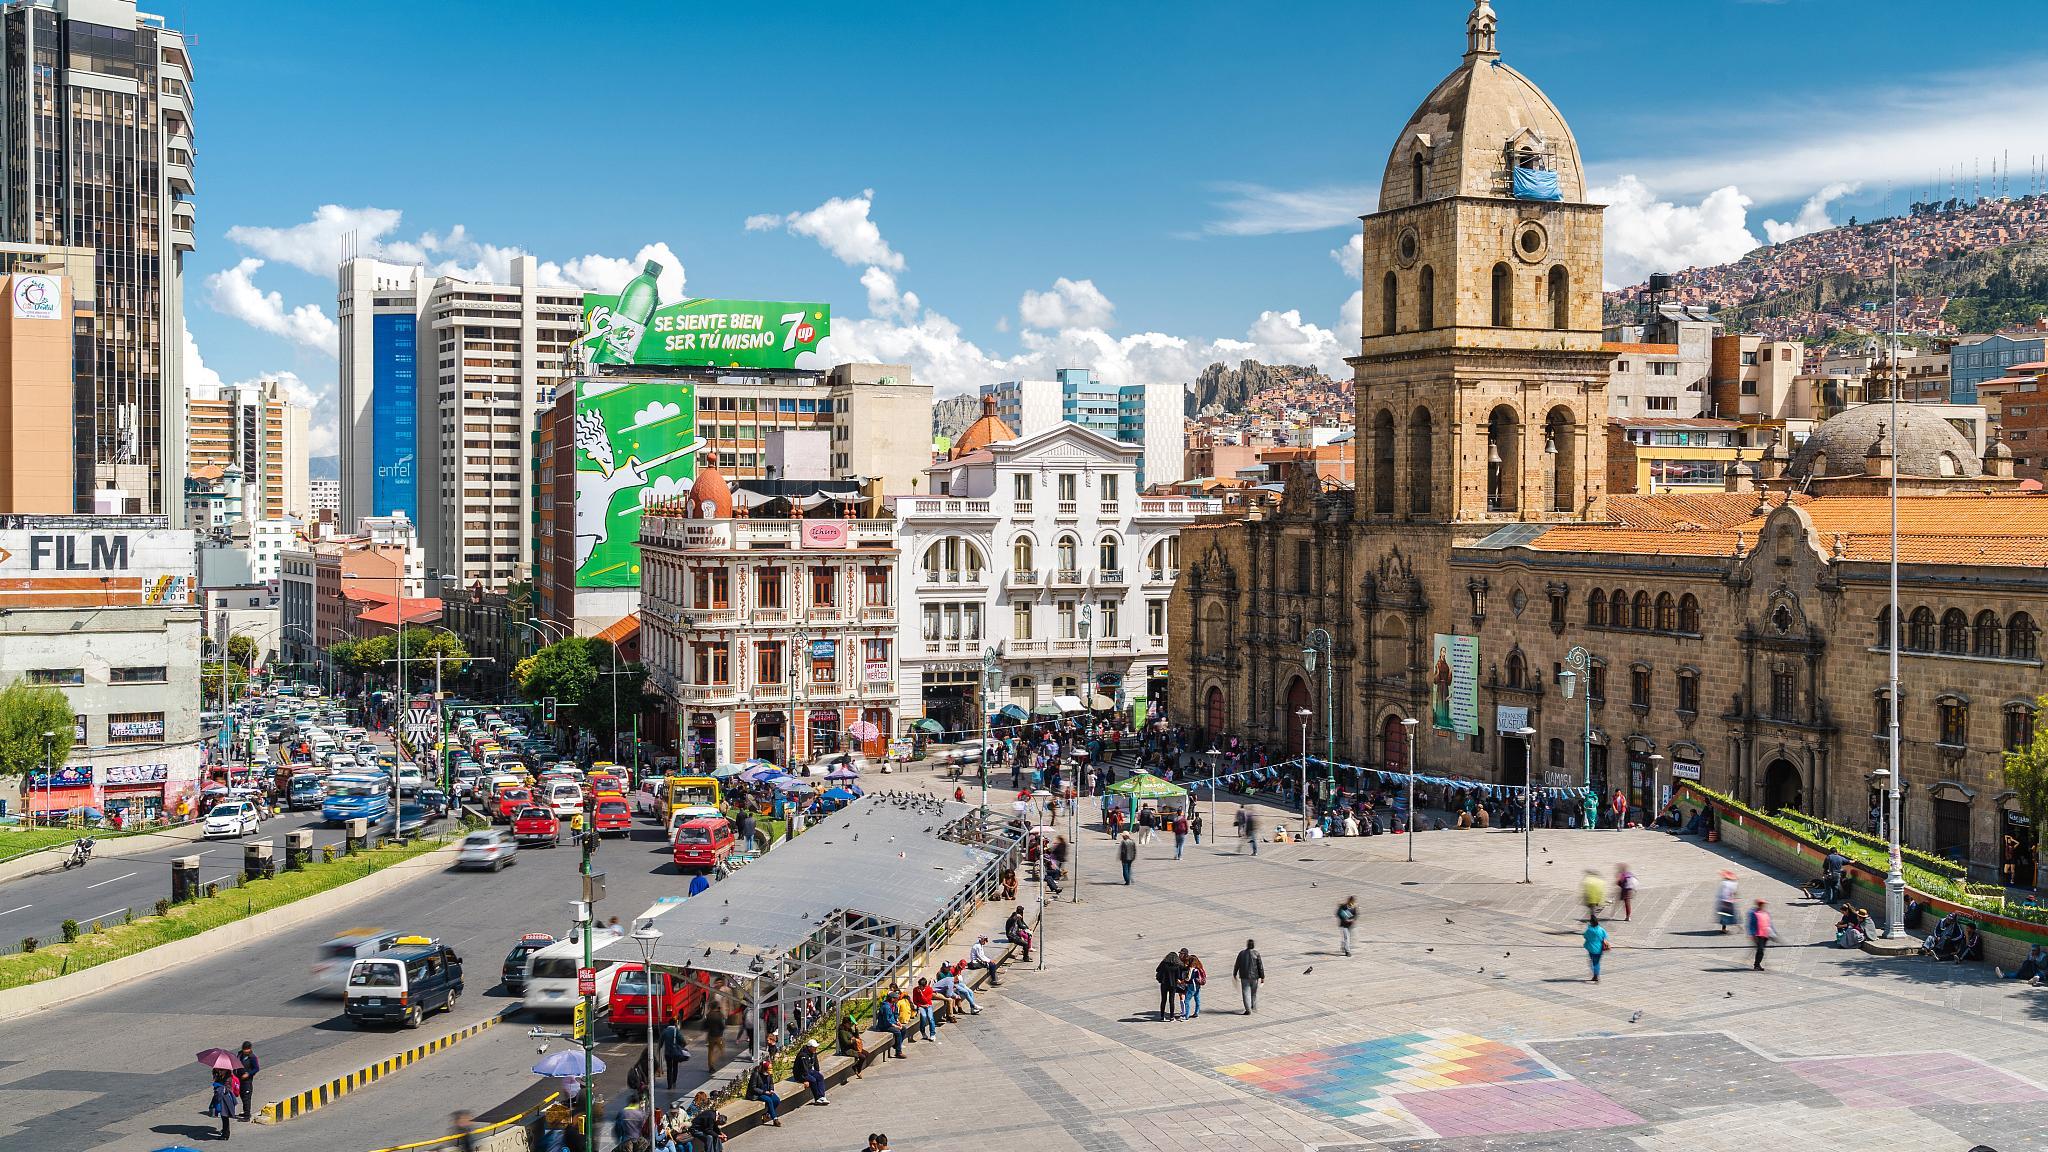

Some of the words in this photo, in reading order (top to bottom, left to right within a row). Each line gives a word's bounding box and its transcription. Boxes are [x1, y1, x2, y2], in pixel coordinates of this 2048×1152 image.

[654, 316, 674, 332] SE
[676, 314, 727, 331] SIENTE
[731, 313, 764, 331] BIEN
[665, 334, 696, 351] SER
[700, 329, 720, 349] TÚ
[722, 331, 775, 349] MISMO
[378, 462, 410, 477] entel
[30, 535, 129, 571] FILM
[145, 593, 186, 601] COLOR
